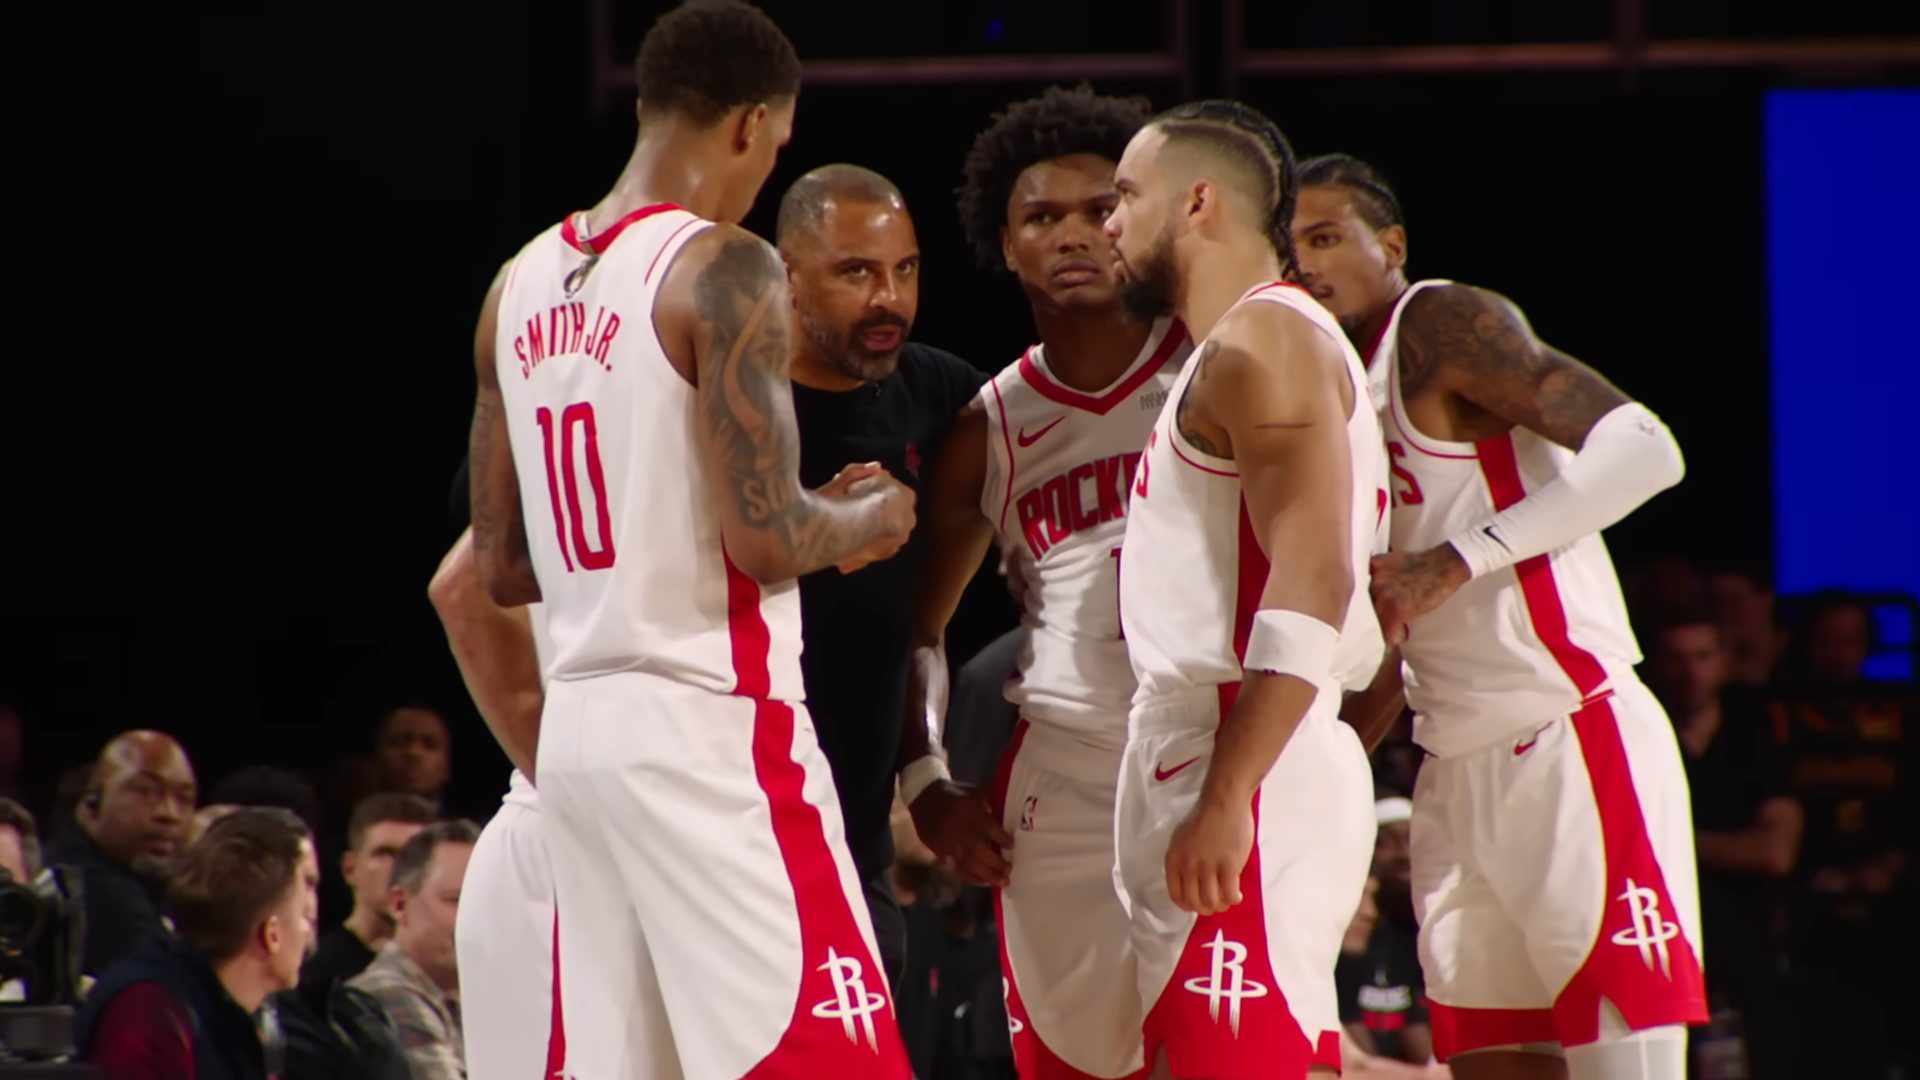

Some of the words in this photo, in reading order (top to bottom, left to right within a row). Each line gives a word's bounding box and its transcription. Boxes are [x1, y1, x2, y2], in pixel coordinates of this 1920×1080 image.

[514, 302, 585, 380] SMITH
[585, 306, 621, 373] JR.
[536, 401, 616, 573] 10
